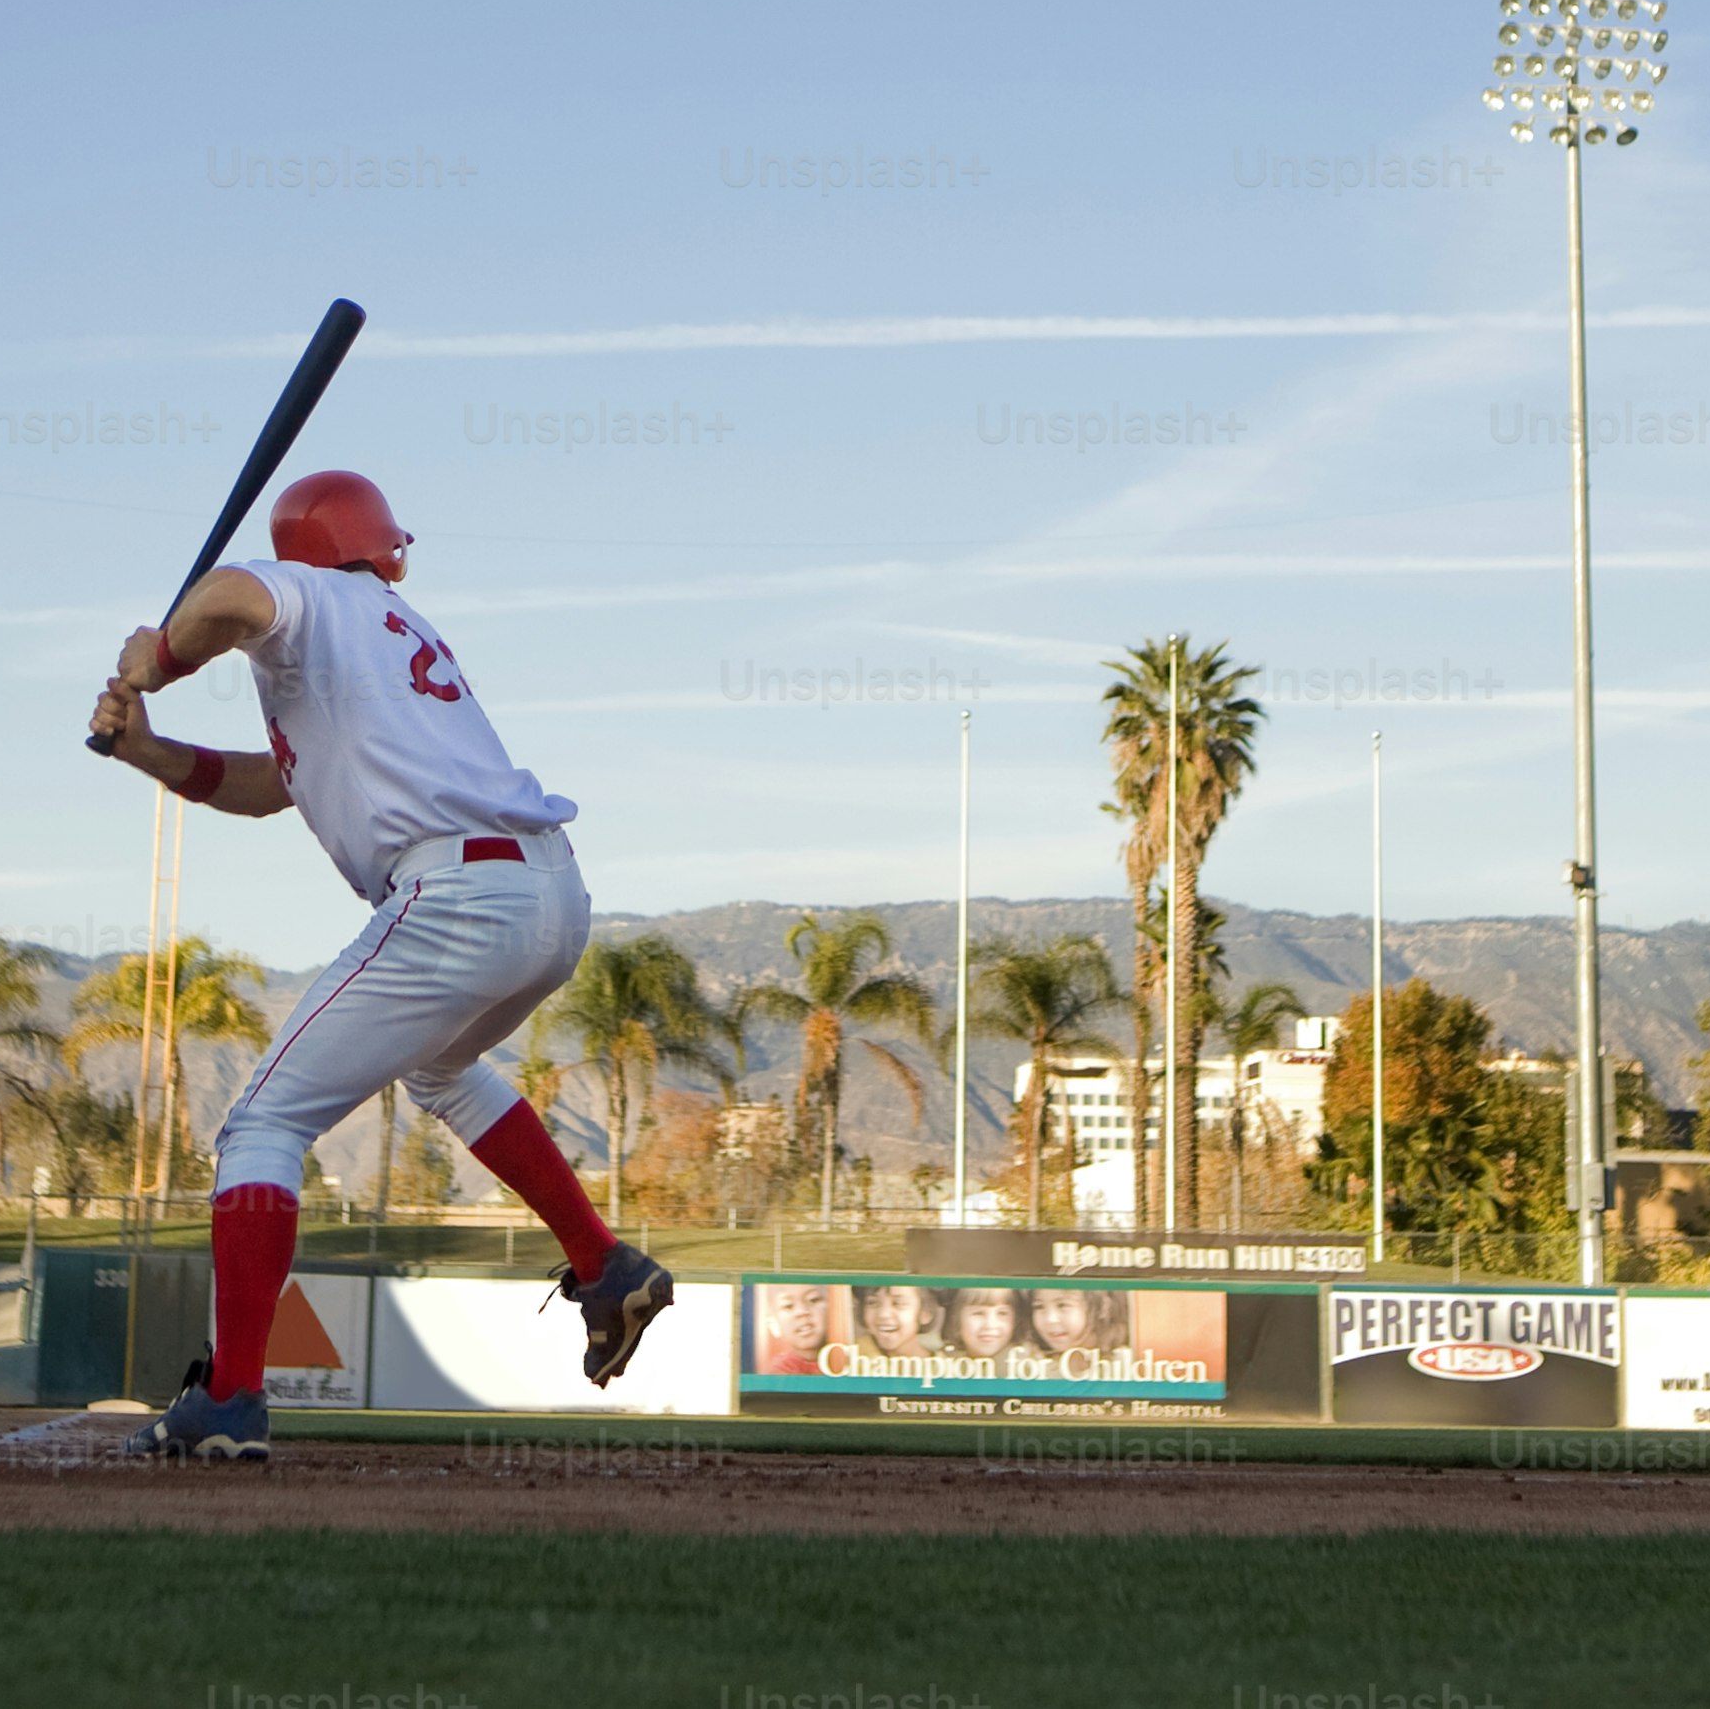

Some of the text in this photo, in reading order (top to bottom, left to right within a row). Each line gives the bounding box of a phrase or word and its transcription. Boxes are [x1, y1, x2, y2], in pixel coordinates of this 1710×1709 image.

[383, 610, 473, 702] 2
[1053, 1242, 1155, 1271] Home
[1160, 1244, 1229, 1271] Run
[1234, 1245, 1293, 1271] Hill
[1335, 1298, 1615, 1358] PERFECT GAME
[817, 1343, 1209, 1388] Champion for Children
[1436, 1346, 1515, 1373] USA
